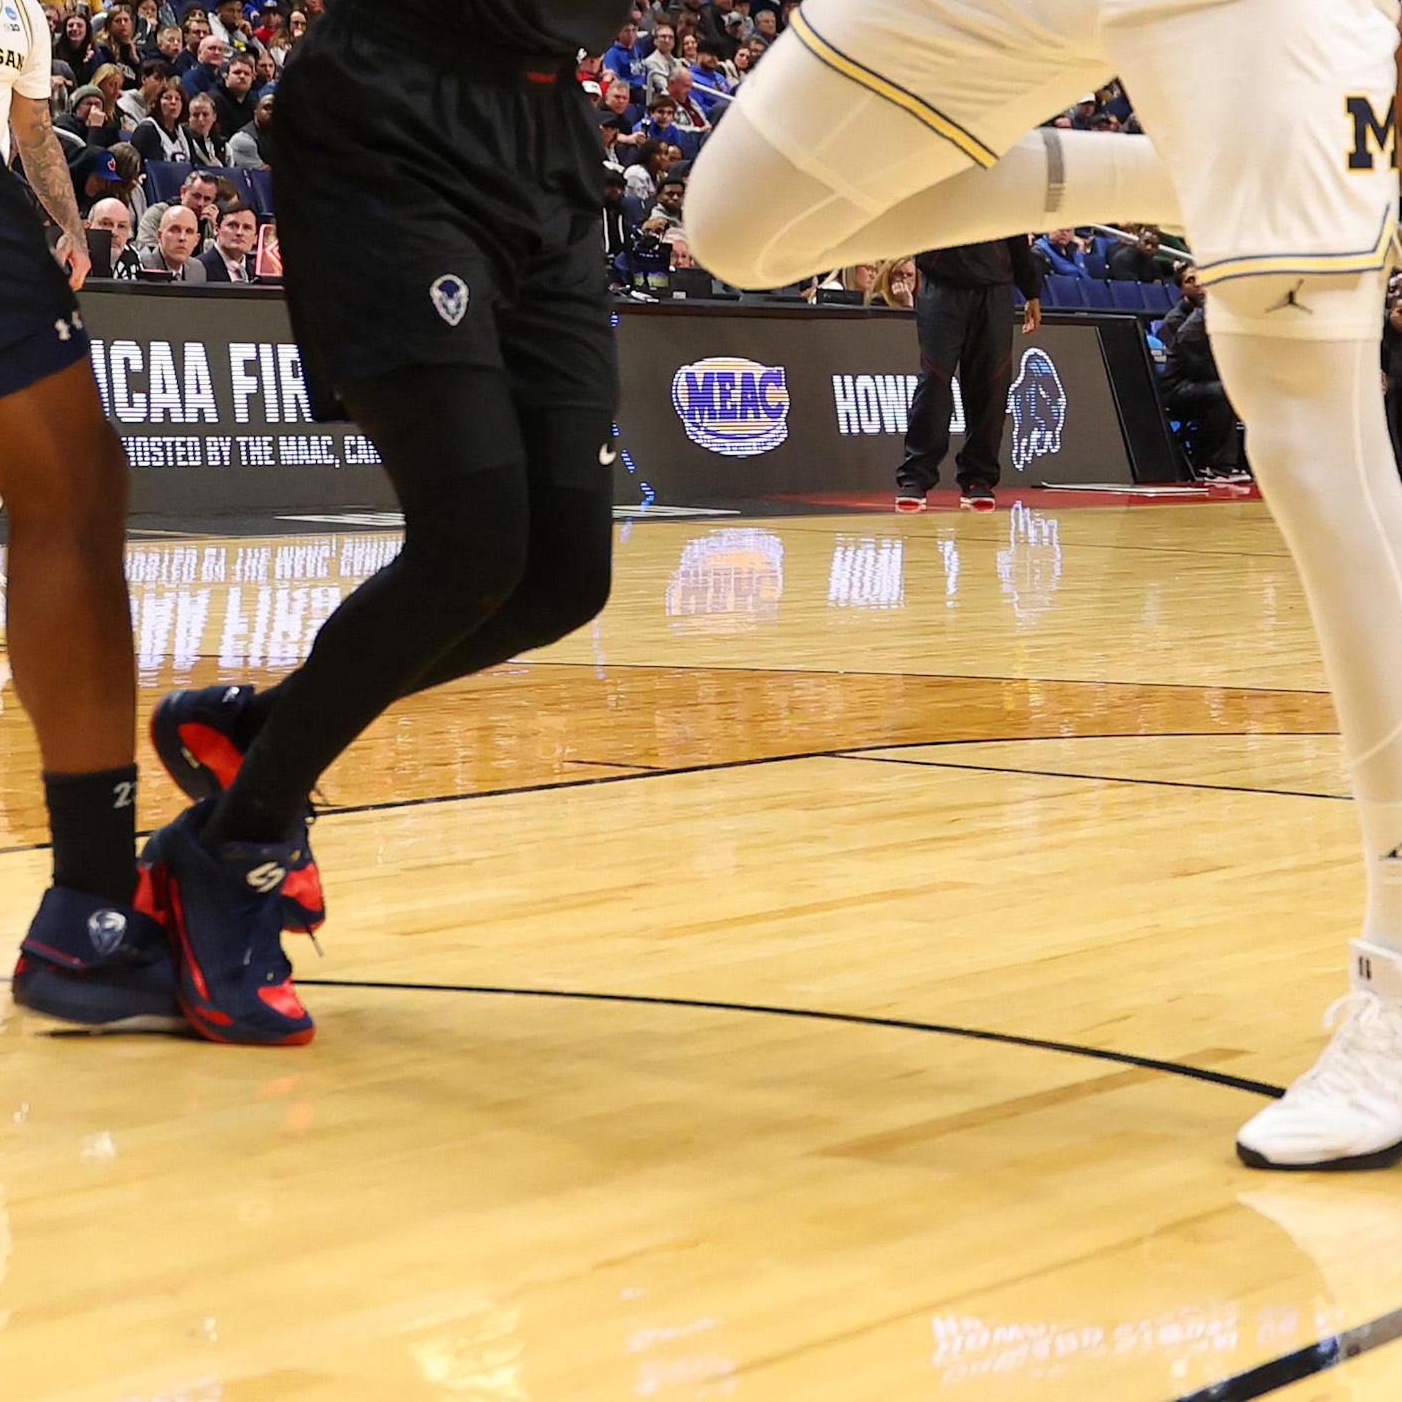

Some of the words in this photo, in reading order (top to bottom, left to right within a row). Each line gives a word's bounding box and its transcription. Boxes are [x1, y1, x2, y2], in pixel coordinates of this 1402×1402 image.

[228, 342, 316, 423] FIR
[684, 370, 786, 421] MEAC
[206, 436, 232, 466] BY
[235, 436, 276, 465] THE
[278, 435, 341, 468] MAAC,
[112, 781, 137, 810] 2
